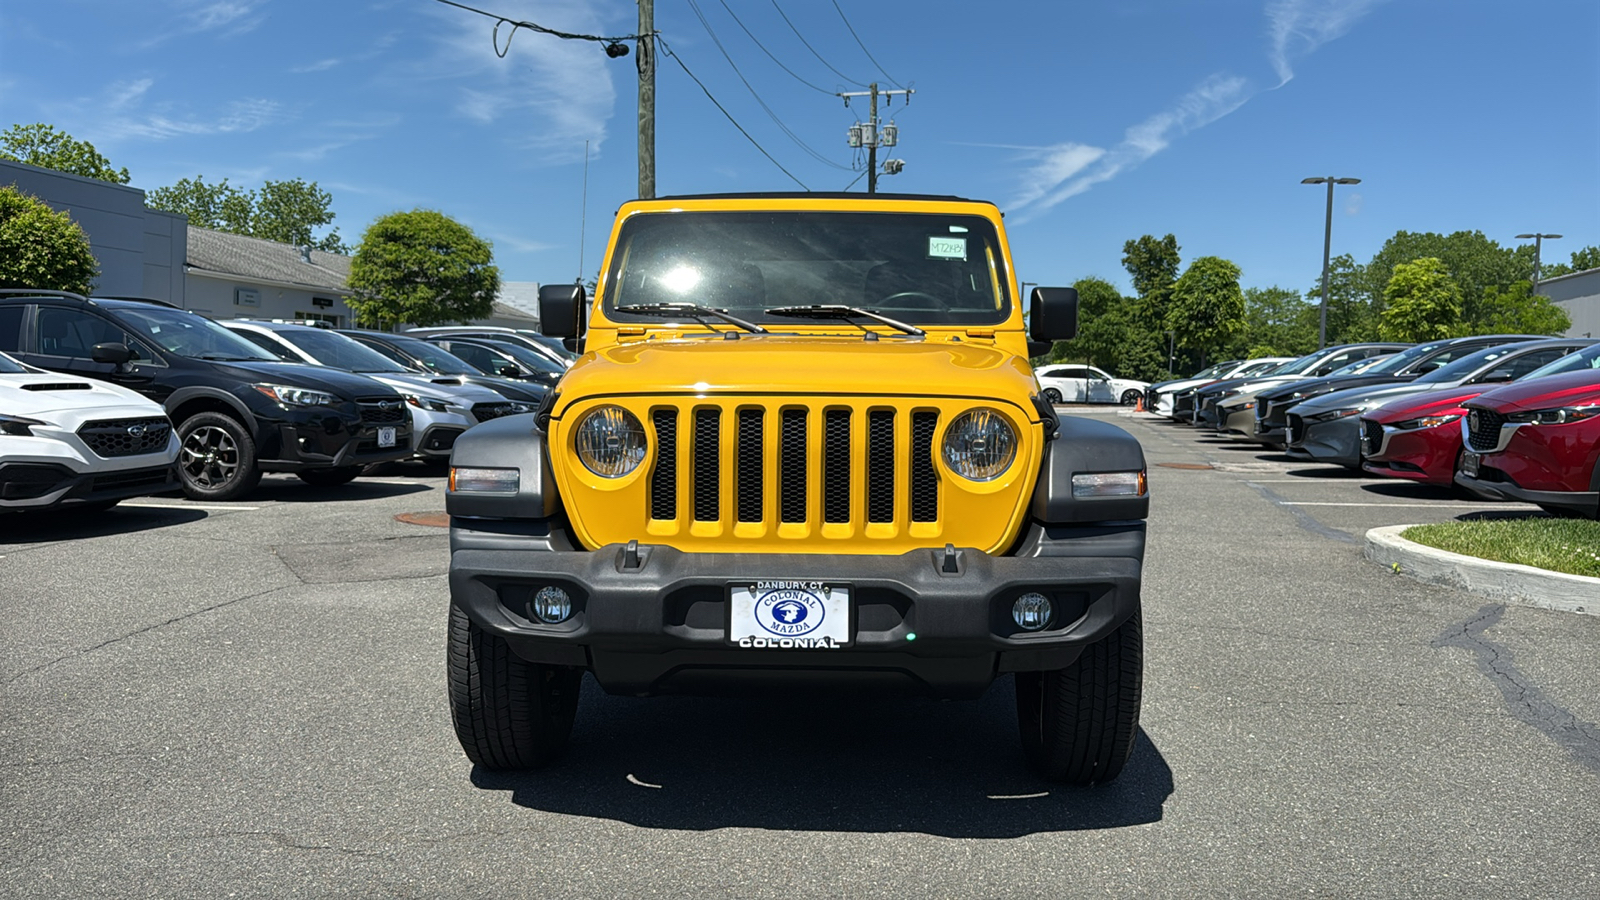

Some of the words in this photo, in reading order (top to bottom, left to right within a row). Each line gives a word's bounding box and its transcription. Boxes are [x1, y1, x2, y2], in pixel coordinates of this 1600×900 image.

[757, 581, 807, 590] DANBURY,
[809, 581, 824, 589] CT
[764, 591, 816, 609] COLONIAL
[770, 621, 811, 633] MAZDA
[739, 637, 841, 649] COLONIAL
